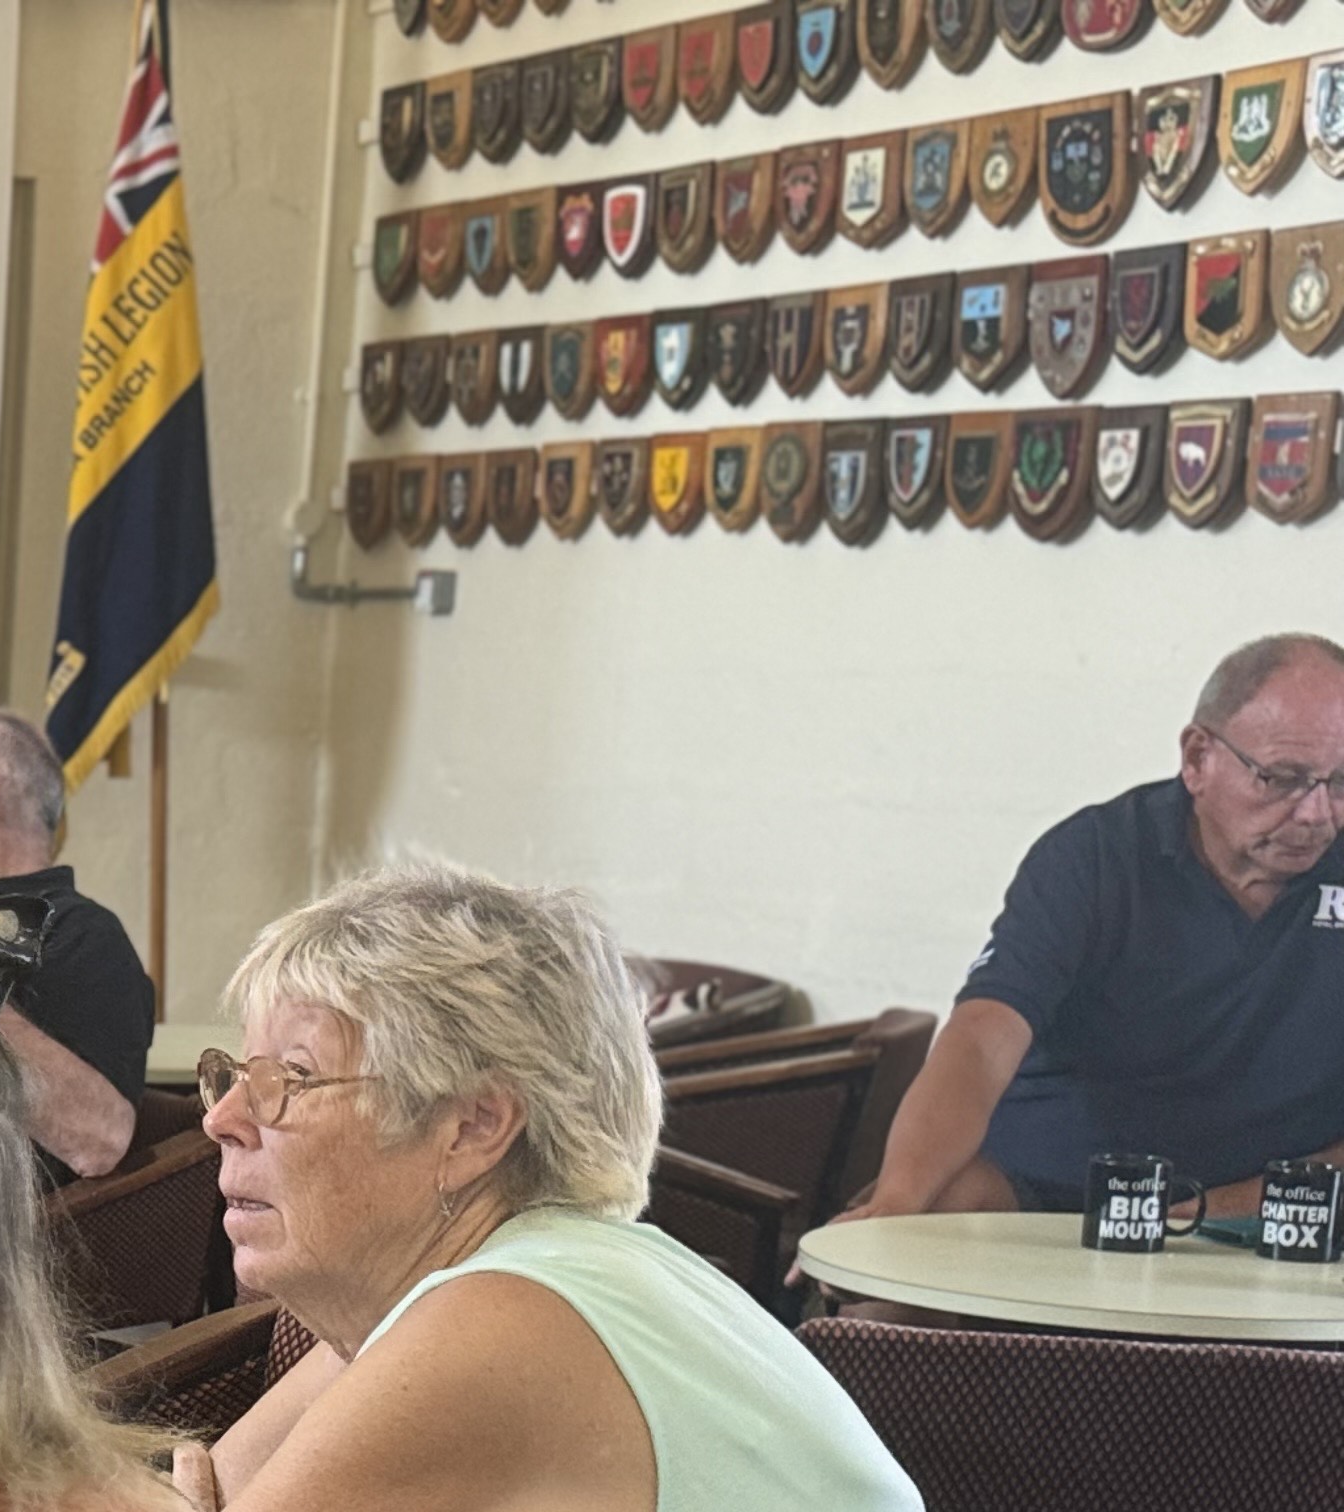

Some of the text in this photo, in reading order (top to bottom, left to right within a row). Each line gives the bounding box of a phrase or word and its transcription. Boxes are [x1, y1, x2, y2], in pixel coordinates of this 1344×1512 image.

[101, 231, 193, 348] LEGION
[78, 358, 156, 452] BRANCH
[1108, 1176, 1167, 1192] the office
[1266, 1183, 1326, 1201] the office
[1110, 1195, 1160, 1220] BIG
[1261, 1200, 1329, 1225] CHATTER
[1098, 1219, 1163, 1240] MOUTH
[1262, 1220, 1321, 1249] BOX
